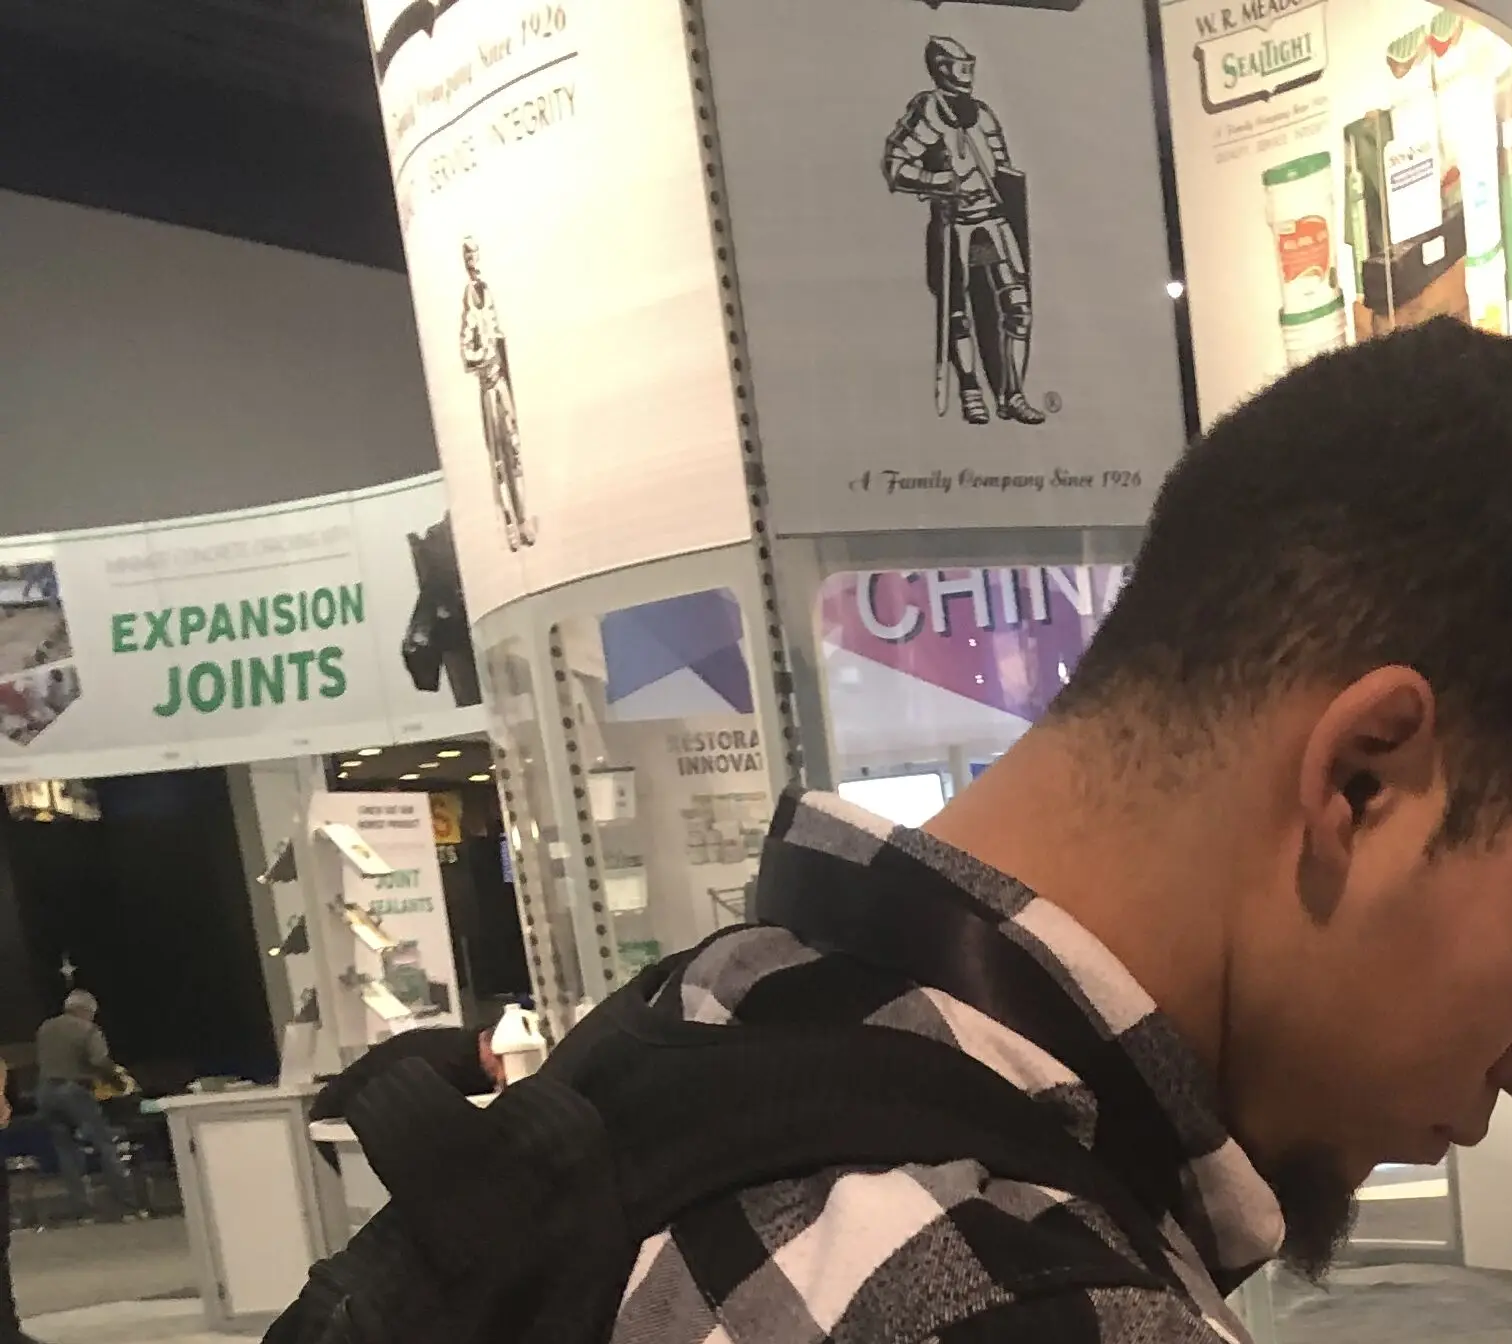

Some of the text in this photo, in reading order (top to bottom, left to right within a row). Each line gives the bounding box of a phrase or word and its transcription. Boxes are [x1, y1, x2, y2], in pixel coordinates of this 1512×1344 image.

[881, 468, 952, 494] Family
[958, 467, 1045, 493] Company
[1051, 467, 1094, 489] Since
[1101, 469, 1142, 489] 1926
[111, 581, 366, 654] EXPANSION
[152, 646, 347, 718] JOINTS
